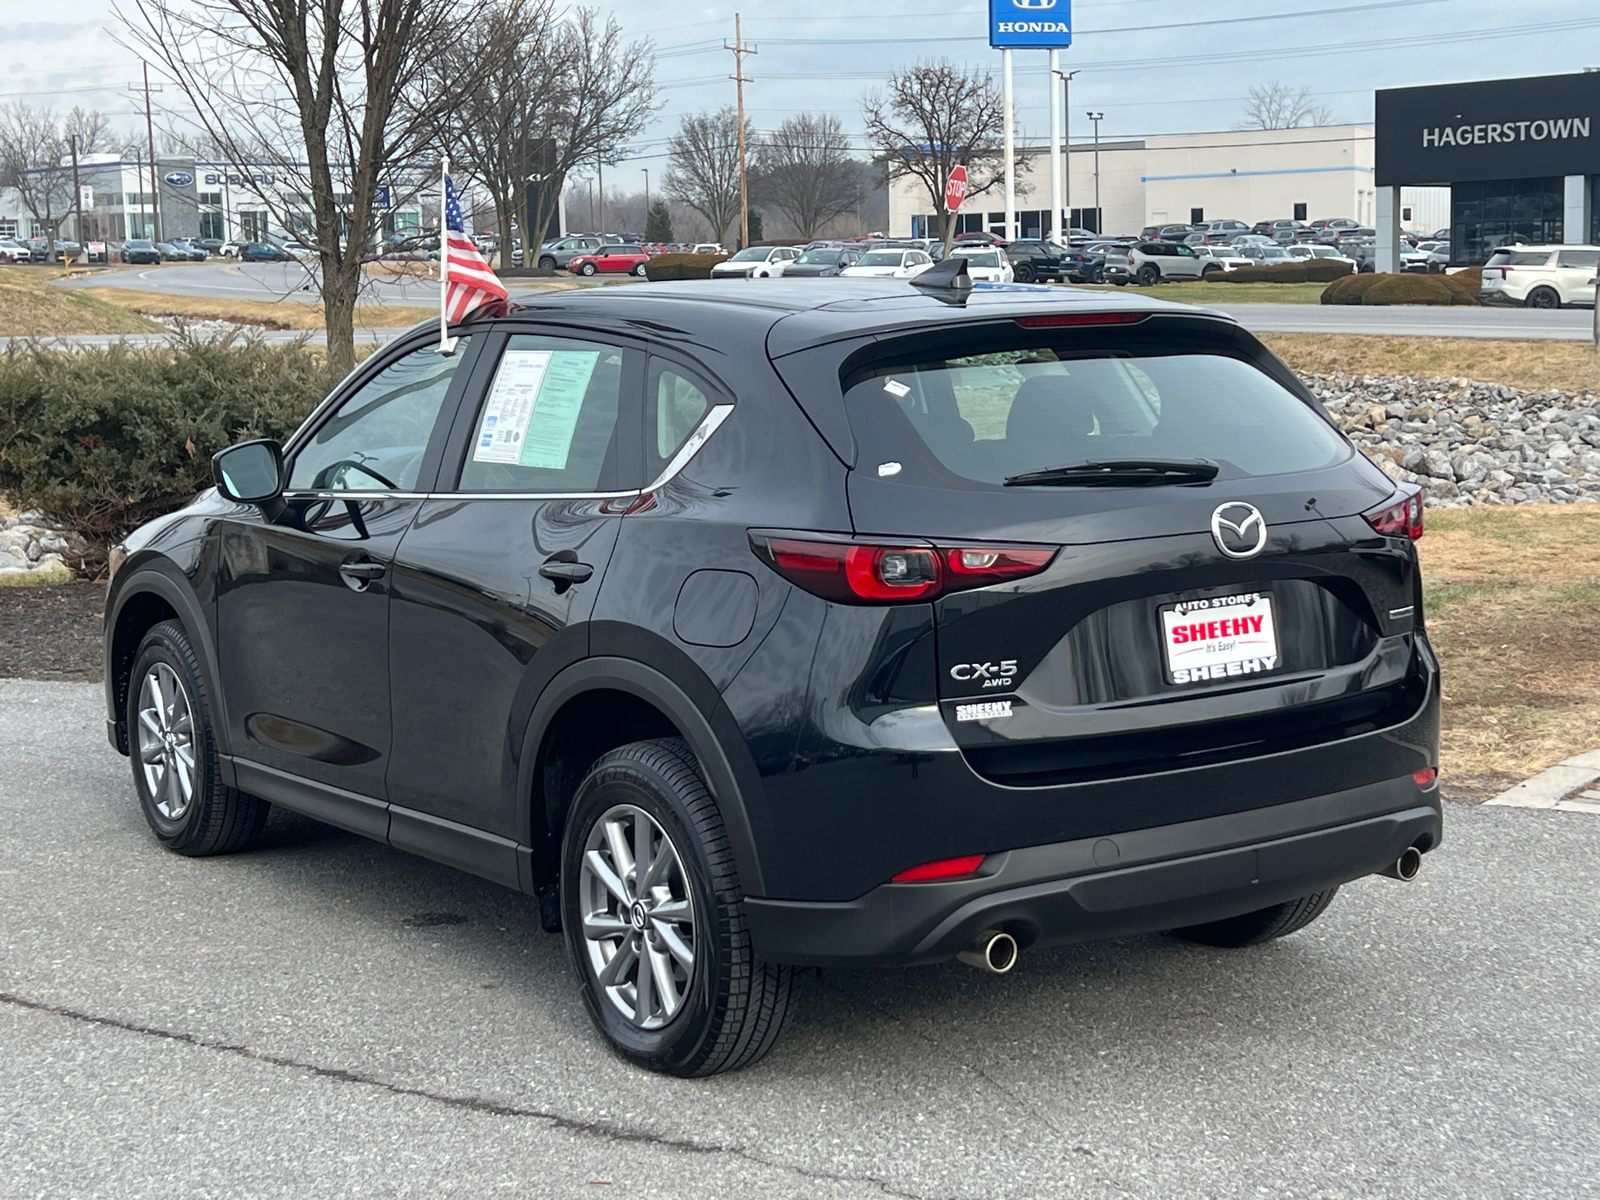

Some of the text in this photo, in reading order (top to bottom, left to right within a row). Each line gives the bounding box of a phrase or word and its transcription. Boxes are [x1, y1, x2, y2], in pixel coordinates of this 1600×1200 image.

[998, 22, 1069, 33] HONDA
[1422, 117, 1591, 148] HAGERSTOWN
[947, 179, 966, 198] STOP
[1174, 592, 1261, 613] AUTO STORES
[1171, 614, 1264, 644] SHEEHY
[950, 659, 1018, 680] CX-5
[1173, 655, 1277, 684] SHEEHY
[982, 677, 1012, 688] AWD
[956, 700, 1012, 715] SHEEHY
